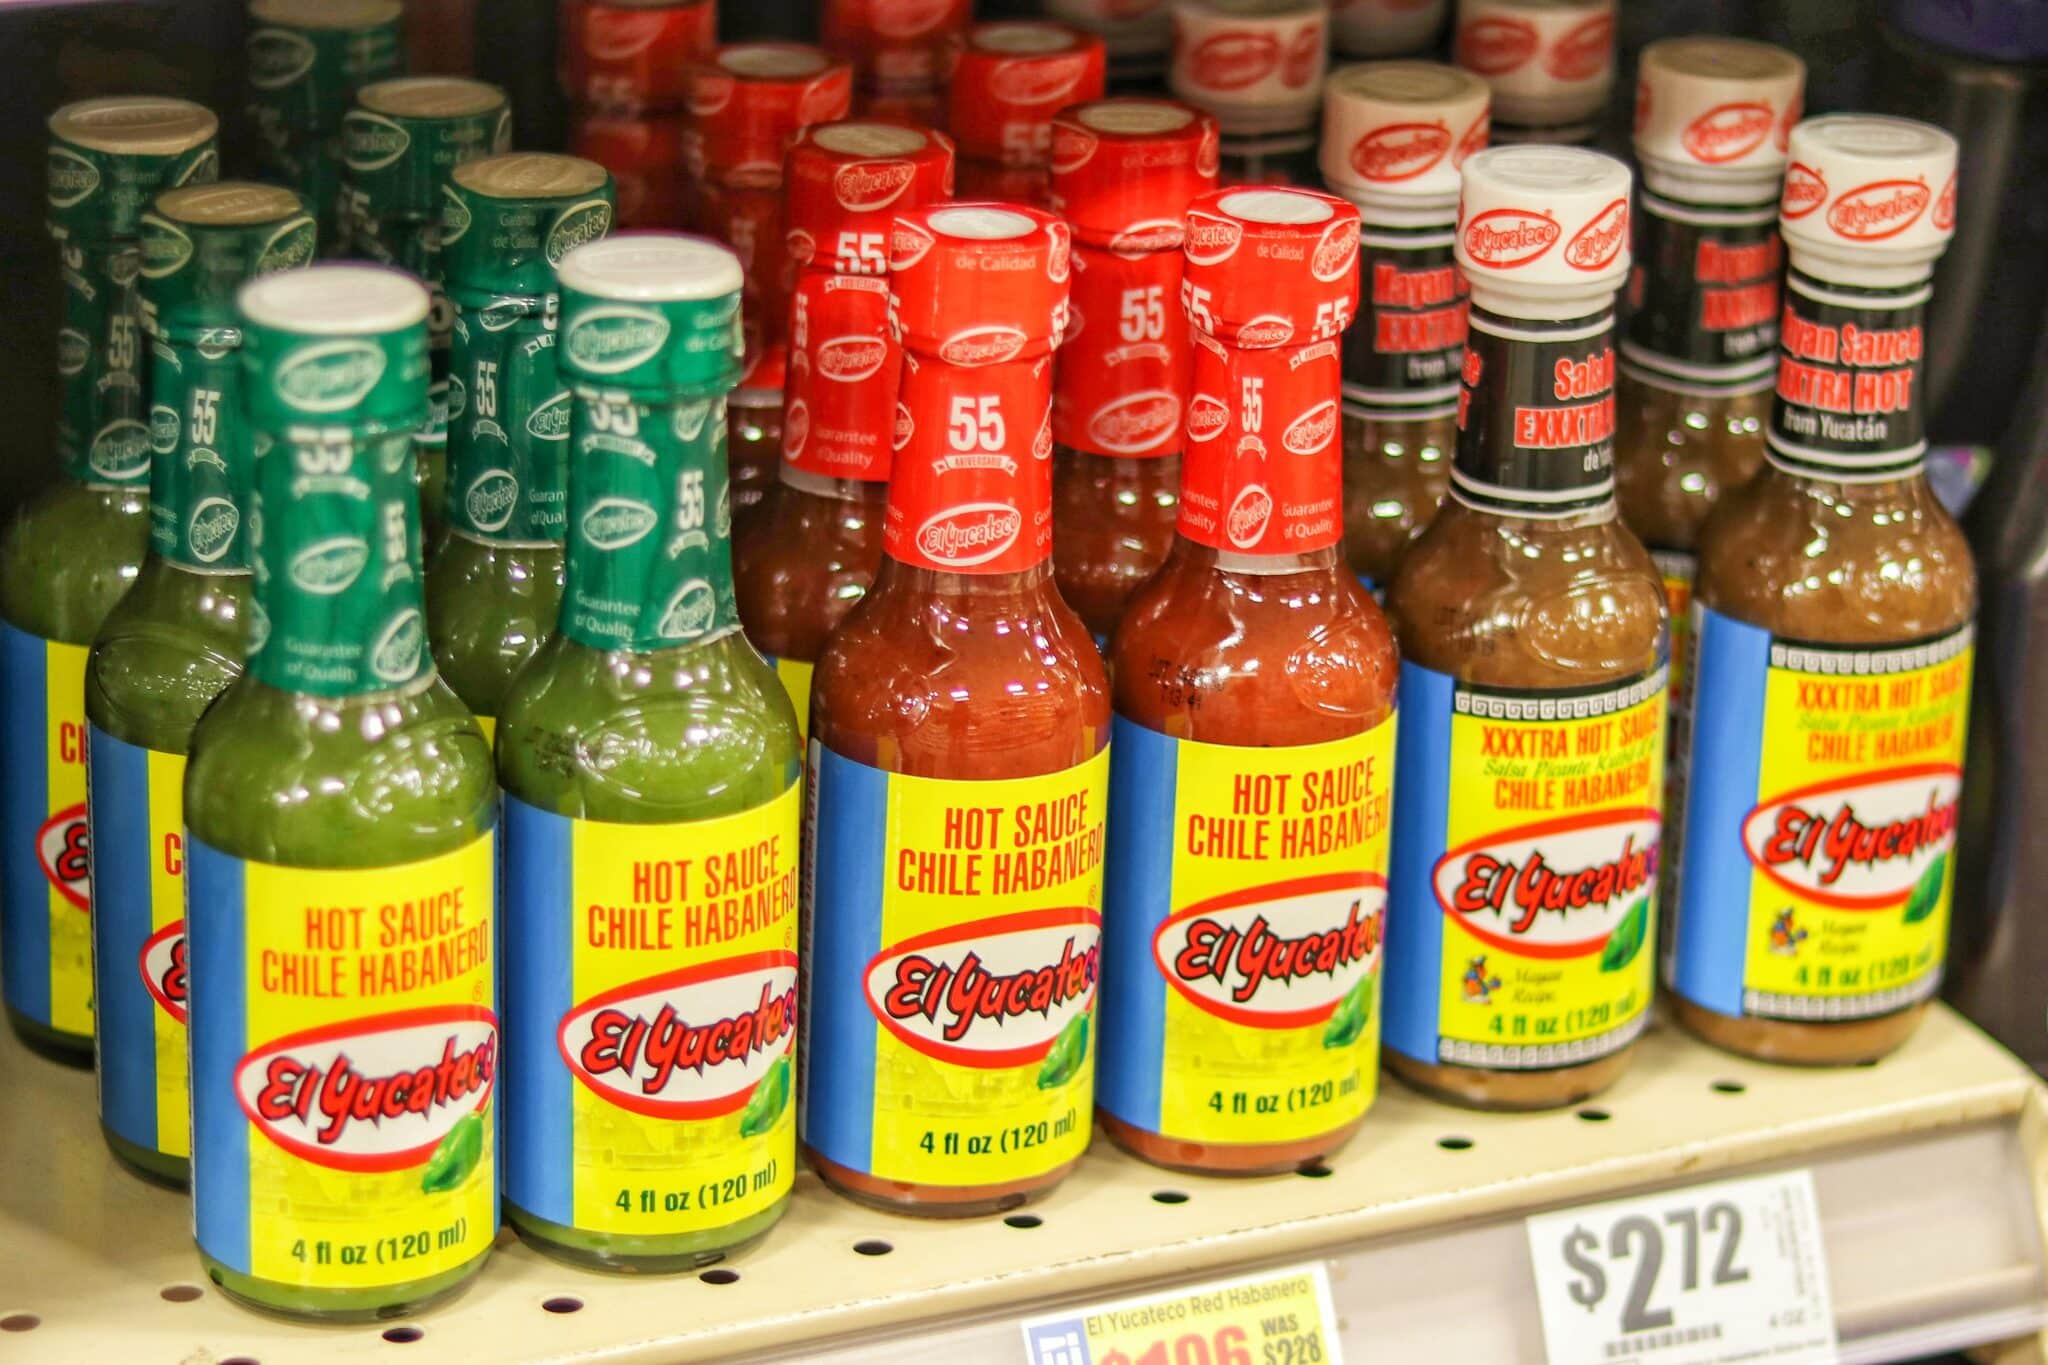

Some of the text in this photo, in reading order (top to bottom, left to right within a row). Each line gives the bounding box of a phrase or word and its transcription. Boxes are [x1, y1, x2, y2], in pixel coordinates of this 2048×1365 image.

[833, 231, 887, 274] 55
[979, 256, 1036, 271] Calidad
[1479, 220, 1556, 260] Yucateco
[108, 315, 136, 369] 55
[1119, 285, 1166, 342] 55
[191, 389, 222, 446] 55
[475, 360, 498, 418] 55
[1241, 376, 1264, 434] 55
[1853, 369, 1914, 415] HOT
[947, 394, 1007, 452] 55
[1819, 413, 1889, 442] Yucatán
[944, 513, 1019, 559] Yucateco
[1576, 721, 1614, 756] HOT
[1232, 755, 1376, 816] HOT SAUCE
[1493, 778, 1556, 812] CHILE
[944, 788, 1089, 851] HOT SAUCE
[1187, 813, 1271, 861] CHILE
[1762, 803, 1827, 870] El
[633, 834, 780, 904] HOT SAUCE
[898, 821, 1103, 897] CHILE HABANERO
[1453, 851, 1519, 919] El
[305, 885, 465, 951] HOT SAUCE
[588, 865, 796, 950] CHILE HABANERO
[261, 918, 489, 998] CHILE HABANERO
[1174, 917, 1243, 987] El
[884, 954, 955, 1026] El
[581, 1008, 648, 1078] El
[1489, 1012, 1504, 1035] 4
[257, 1030, 496, 1145] El Yucateco
[1208, 1090, 1224, 1113] 4
[1232, 1092, 1247, 1115] fl
[1255, 1094, 1280, 1115] oz
[1286, 1079, 1334, 1113] (120
[919, 1107, 1077, 1156] 4 fl oz (120 ml)
[615, 1158, 778, 1213] 4 fl oz (120 ml)
[291, 1217, 468, 1265] 4 fl oz (120 ml)
[1086, 1276, 1309, 1337] El Yucateco Red Habanero
[1260, 1313, 1299, 1338] WAS
